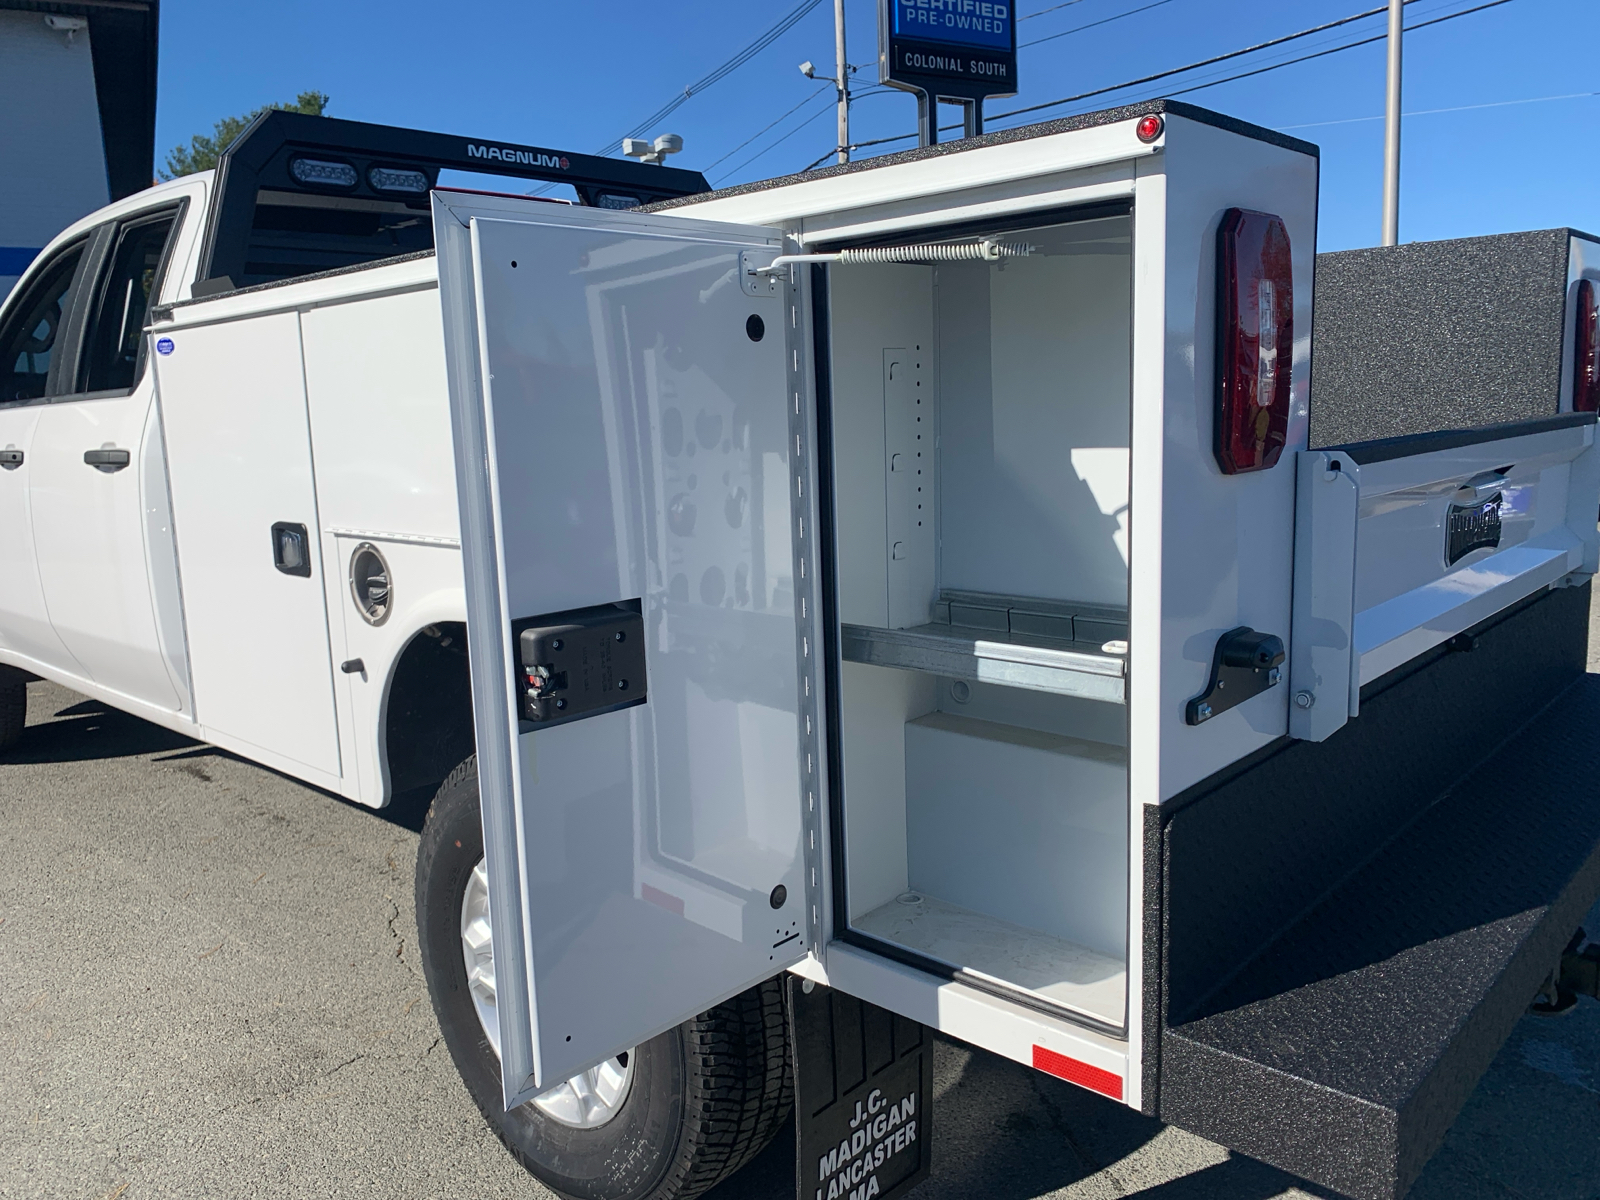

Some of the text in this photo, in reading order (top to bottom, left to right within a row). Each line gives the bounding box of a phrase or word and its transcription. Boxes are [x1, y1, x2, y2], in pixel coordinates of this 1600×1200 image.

[906, 8, 1003, 34] PRE-OWNED
[905, 52, 1007, 77] COLONIAL SOUTH
[467, 144, 560, 168] MAGNUM
[849, 1088, 887, 1128] J.C.
[819, 1092, 915, 1181] MADIGAN
